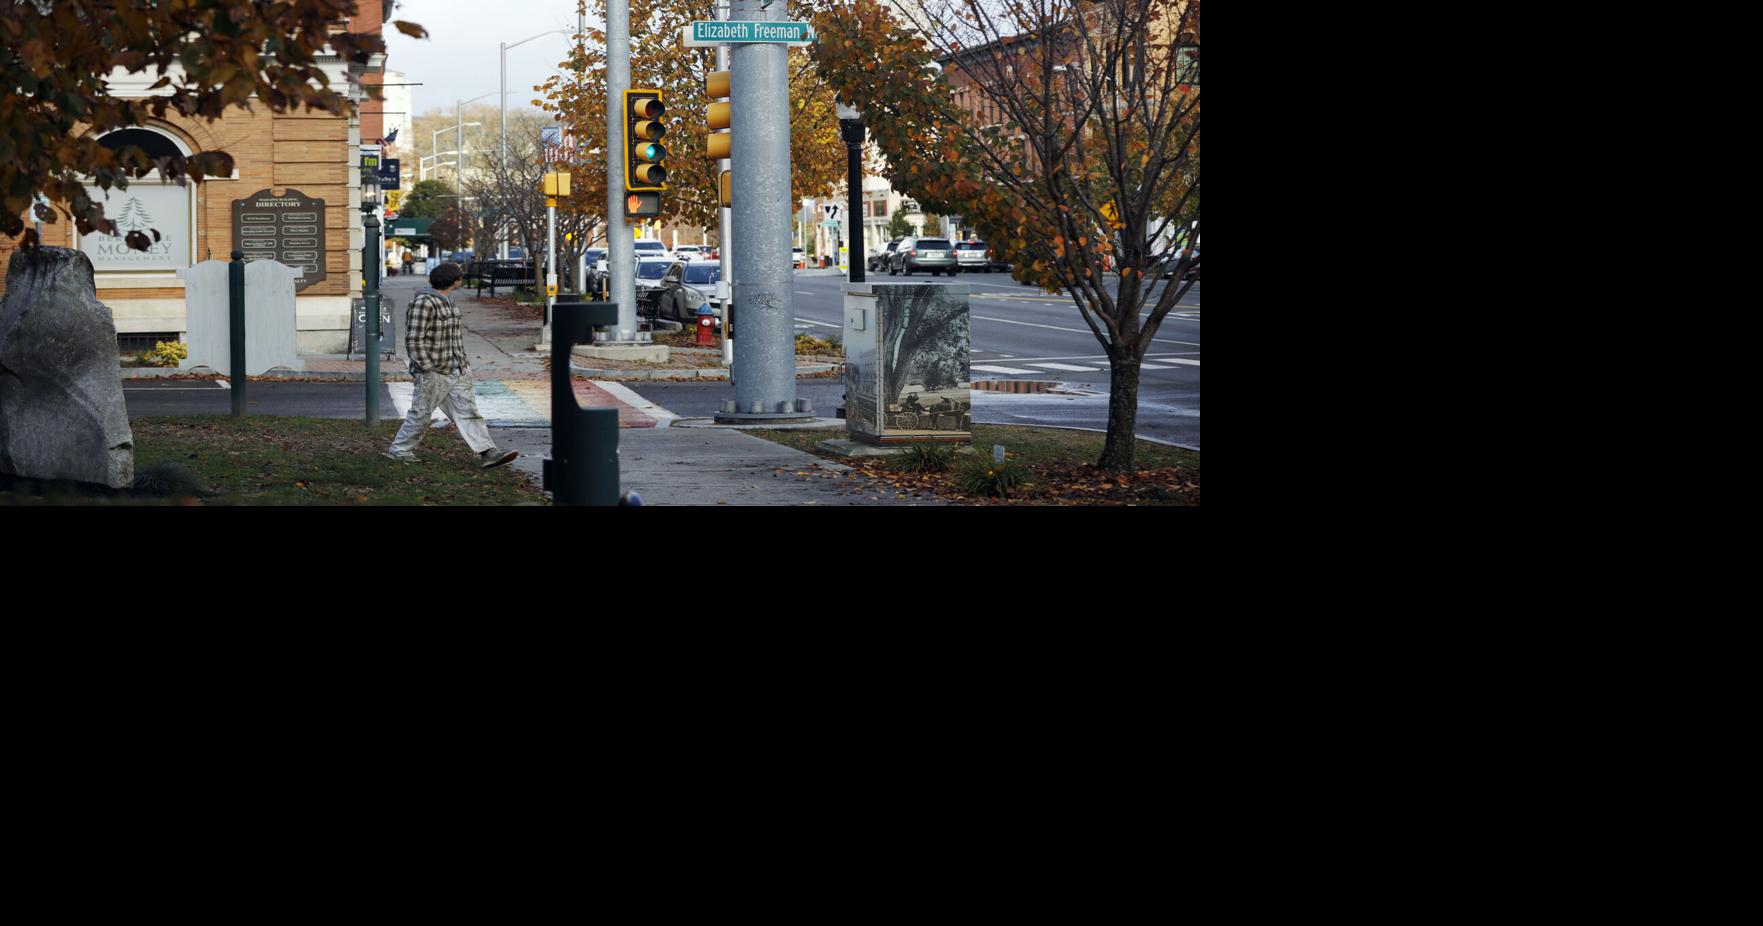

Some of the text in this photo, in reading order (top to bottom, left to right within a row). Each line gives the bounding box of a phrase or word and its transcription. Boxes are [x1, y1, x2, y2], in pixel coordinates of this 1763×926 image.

[697, 22, 820, 39] Elizabeth Freeman W
[97, 243, 172, 255] MOEY
[358, 313, 391, 323] ON
